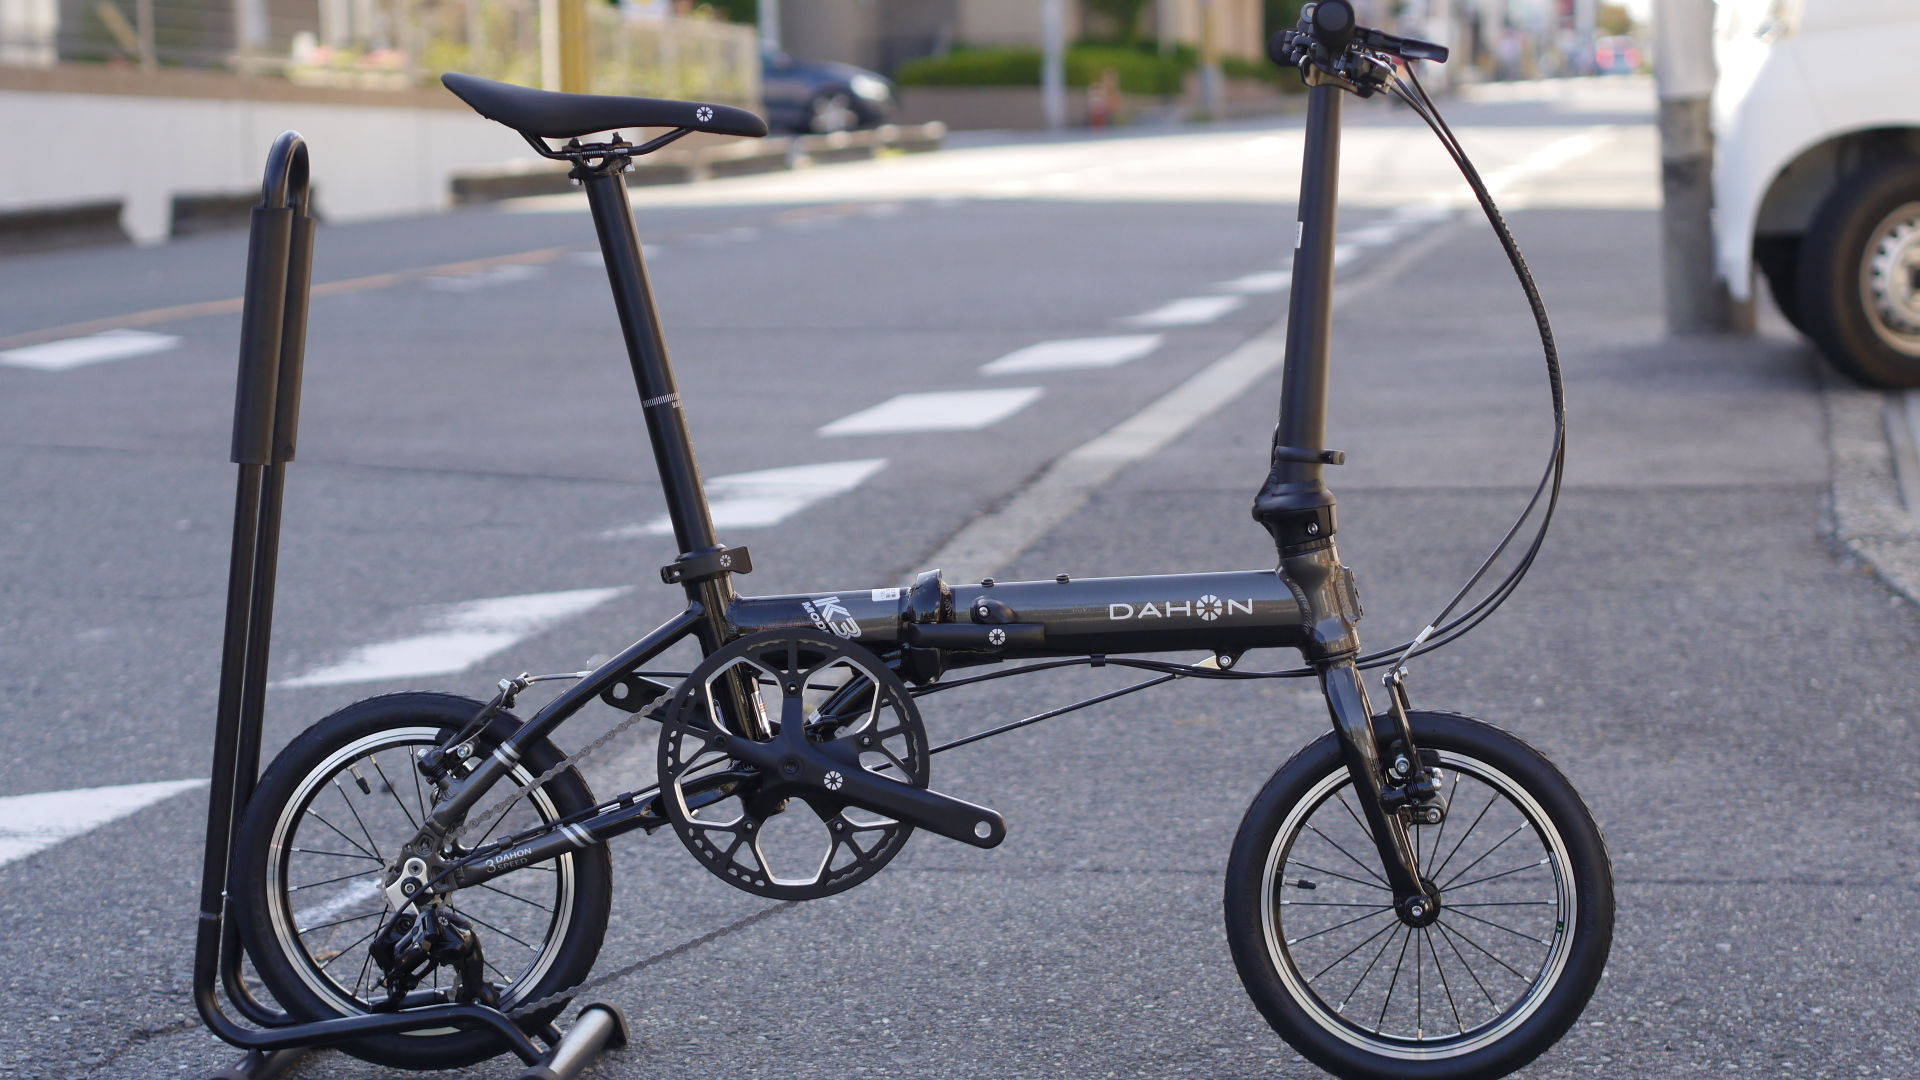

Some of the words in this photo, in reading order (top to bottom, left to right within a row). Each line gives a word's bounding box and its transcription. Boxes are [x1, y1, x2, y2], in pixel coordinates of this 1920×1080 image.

[812, 596, 862, 640] K3
[1109, 594, 1253, 621] DAHON
[495, 847, 532, 863] DAHON
[497, 857, 528, 871] SPEED
